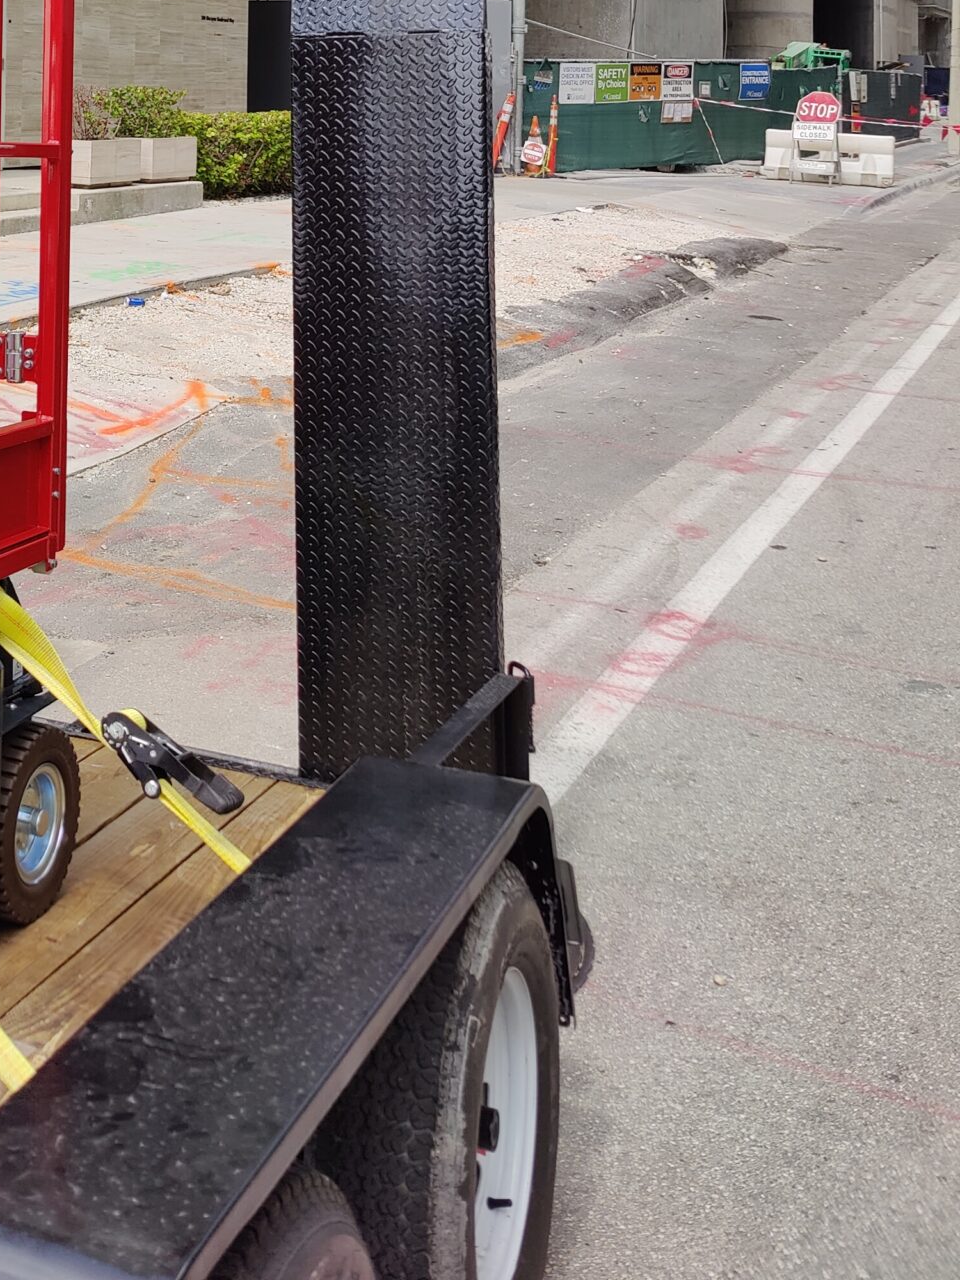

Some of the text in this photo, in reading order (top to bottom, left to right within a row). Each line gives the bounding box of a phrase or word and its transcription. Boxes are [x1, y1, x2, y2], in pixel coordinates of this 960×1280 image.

[598, 69, 627, 79] SAFETY
[633, 65, 659, 73] WARNING
[598, 79, 626, 90] By Choice
[742, 76, 769, 85] ENTRANCE
[800, 102, 837, 118] STOP
